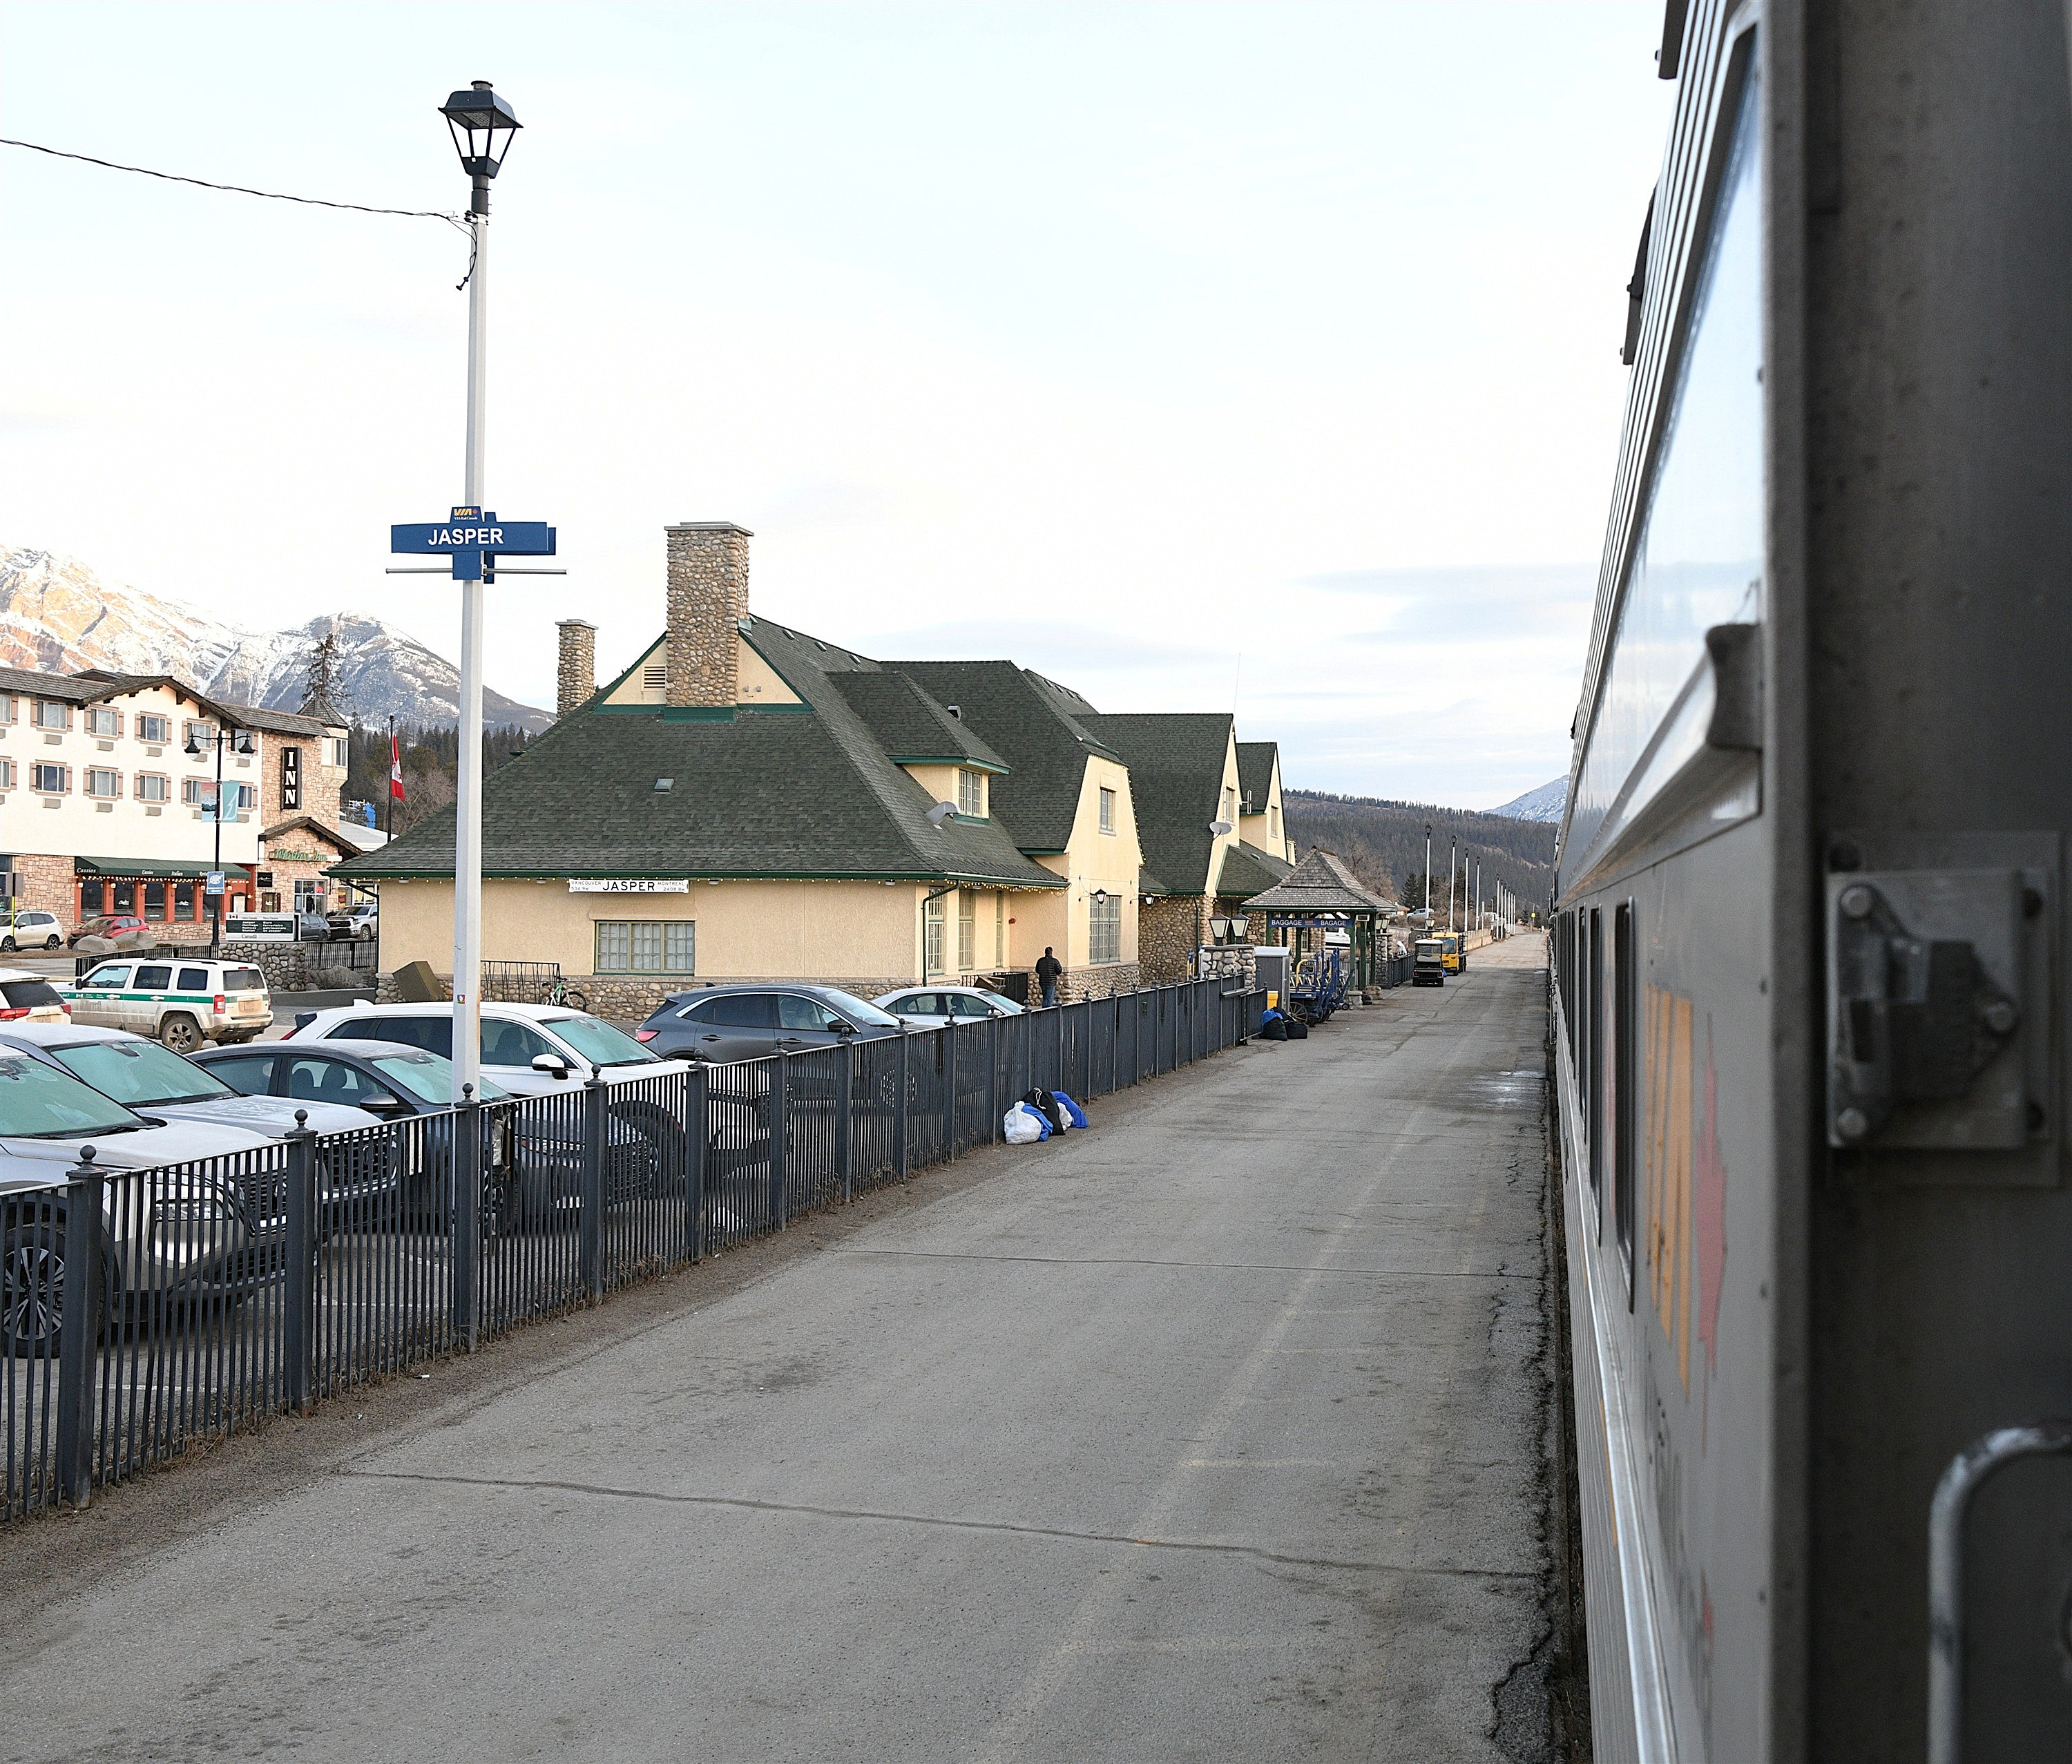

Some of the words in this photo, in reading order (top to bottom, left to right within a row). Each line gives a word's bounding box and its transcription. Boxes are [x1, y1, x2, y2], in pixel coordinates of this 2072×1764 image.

[428, 528, 504, 546] JASPER
[285, 751, 296, 805] INN
[602, 881, 655, 891] JASPER
